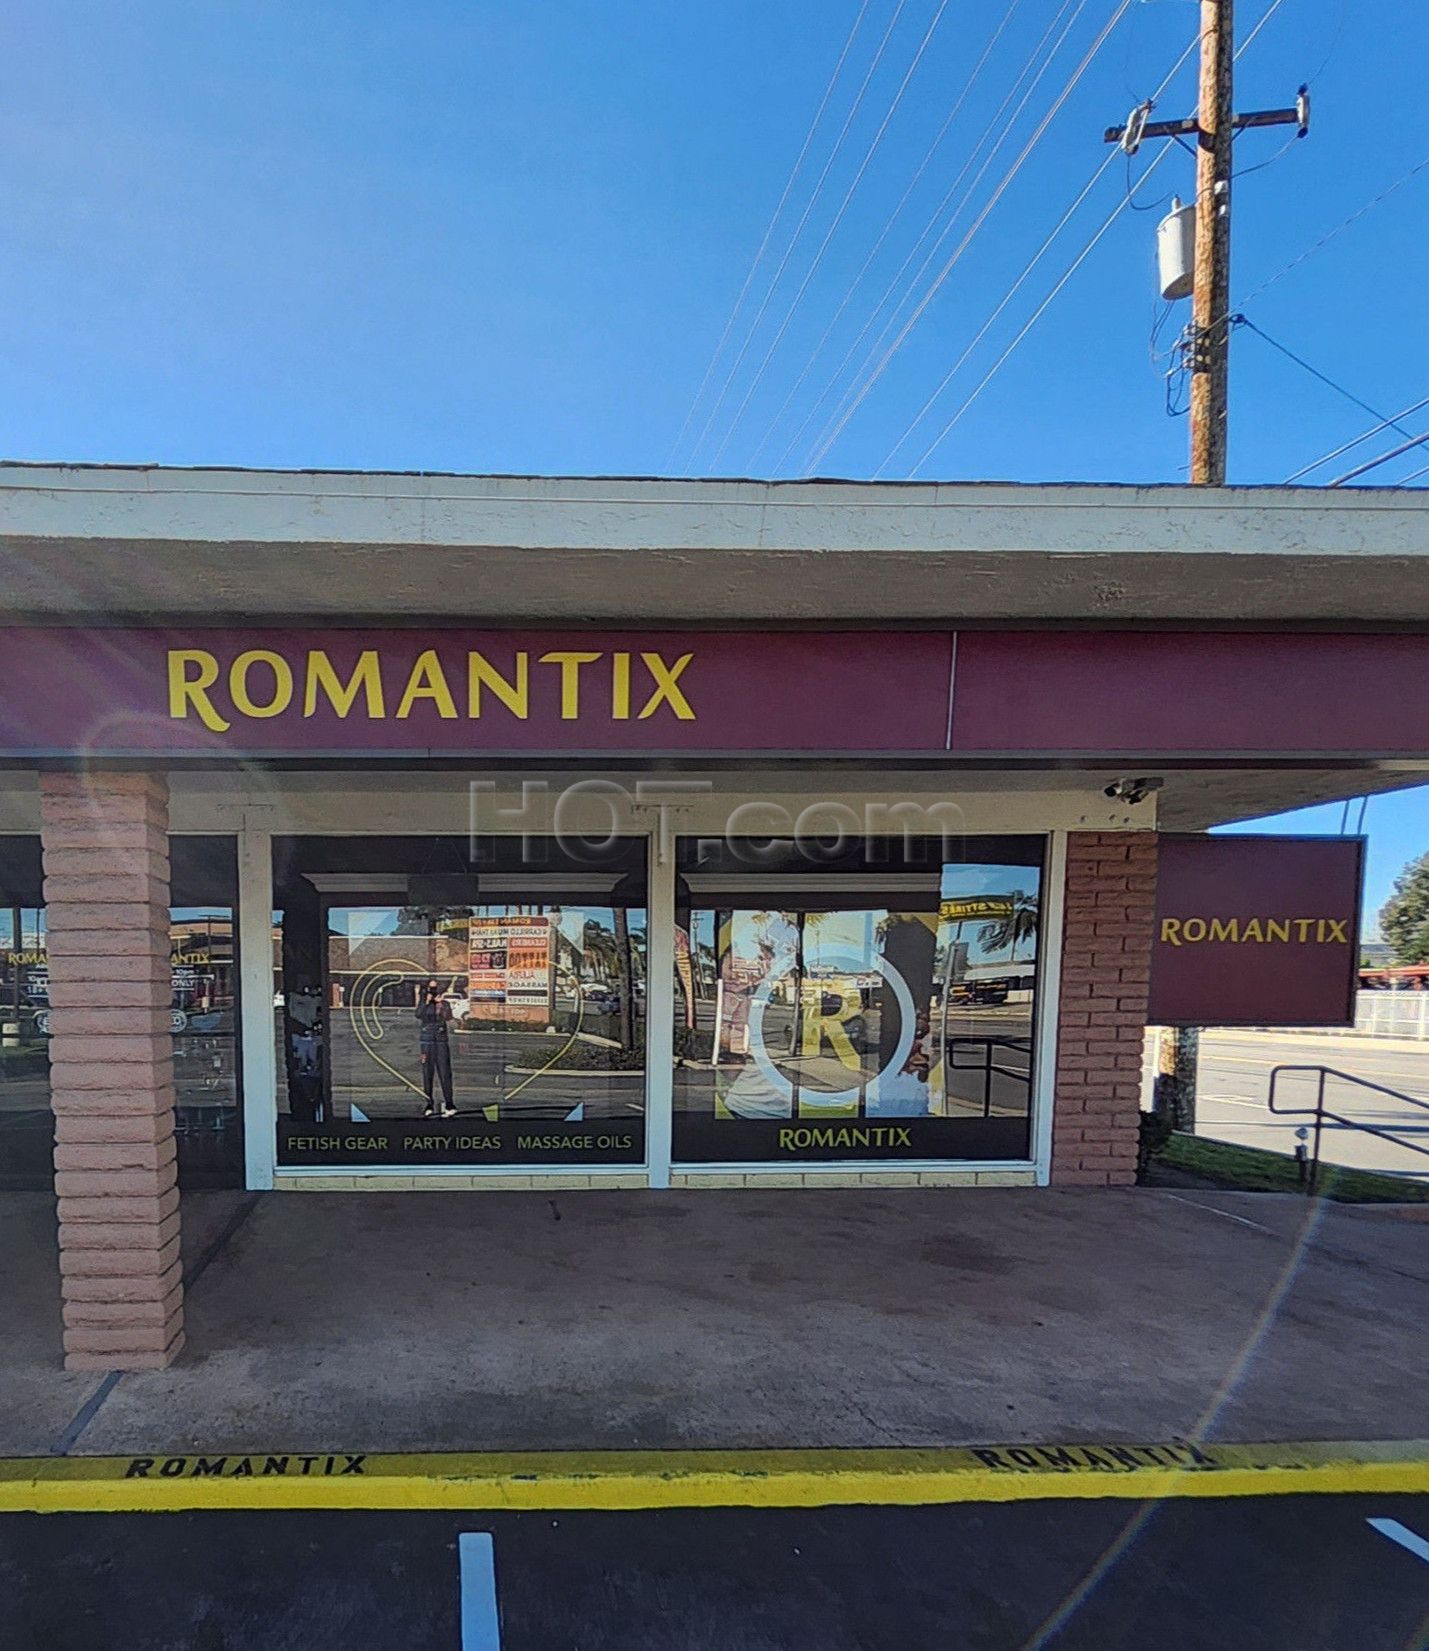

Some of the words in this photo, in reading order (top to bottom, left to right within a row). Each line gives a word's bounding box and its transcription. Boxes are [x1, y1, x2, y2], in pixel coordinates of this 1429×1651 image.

[167, 649, 696, 732] ROMANTIX
[1160, 917, 1348, 946] ROMANTIX
[287, 1136, 340, 1150] FETISH
[344, 1136, 388, 1150] GEAR
[403, 1136, 452, 1150] PARTY
[455, 1136, 502, 1150] IDEAS
[517, 1135, 593, 1149] MASSAGE
[597, 1135, 632, 1149] OILS
[779, 1127, 912, 1151] ROMANTIX
[969, 1436, 1219, 1473] ROMANTIX
[125, 1455, 367, 1478] ROMANTIX
